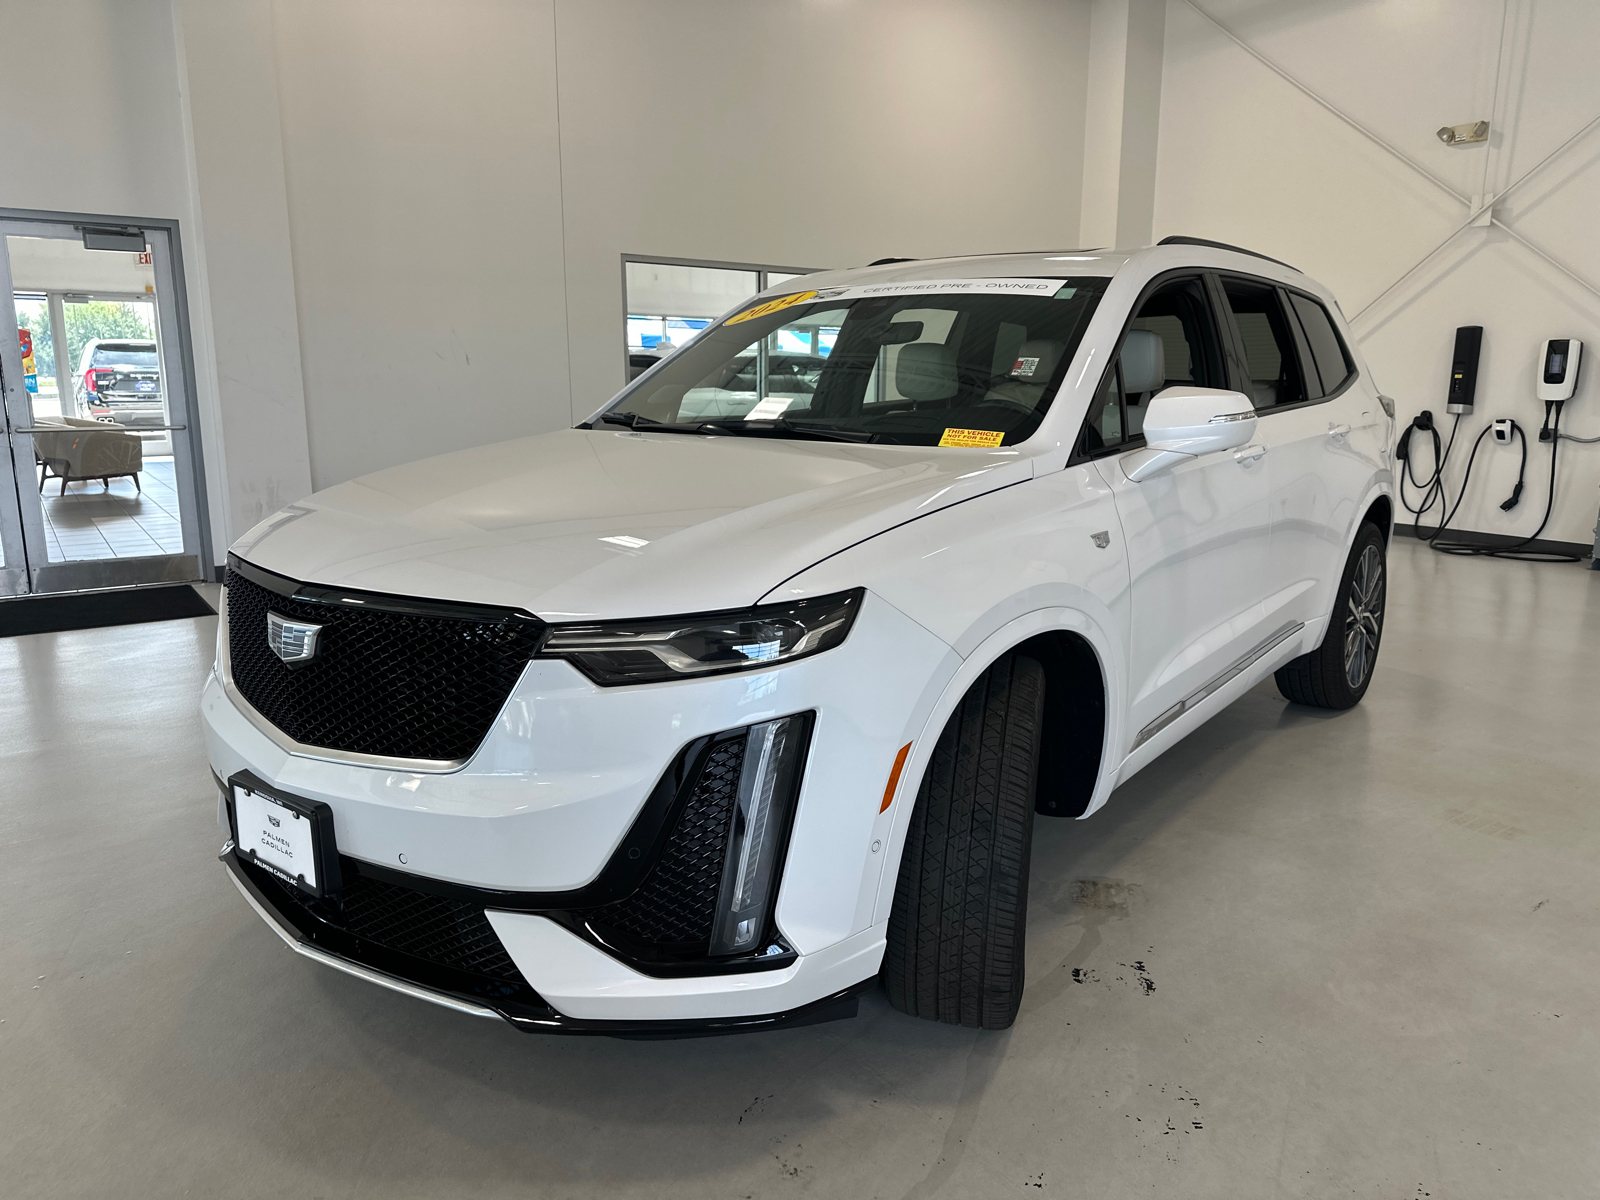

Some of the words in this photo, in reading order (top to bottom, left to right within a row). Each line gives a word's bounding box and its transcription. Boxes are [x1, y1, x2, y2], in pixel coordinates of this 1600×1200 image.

[139, 253, 151, 264] EXI
[863, 284, 938, 294] CERTIFIED
[985, 281, 1049, 290] OWNED
[733, 293, 806, 324] 2024
[261, 838, 293, 858] CADILLAC
[262, 829, 290, 848] PALMEN
[253, 858, 274, 874] PALMEN
[273, 868, 298, 887] CADILLAC
